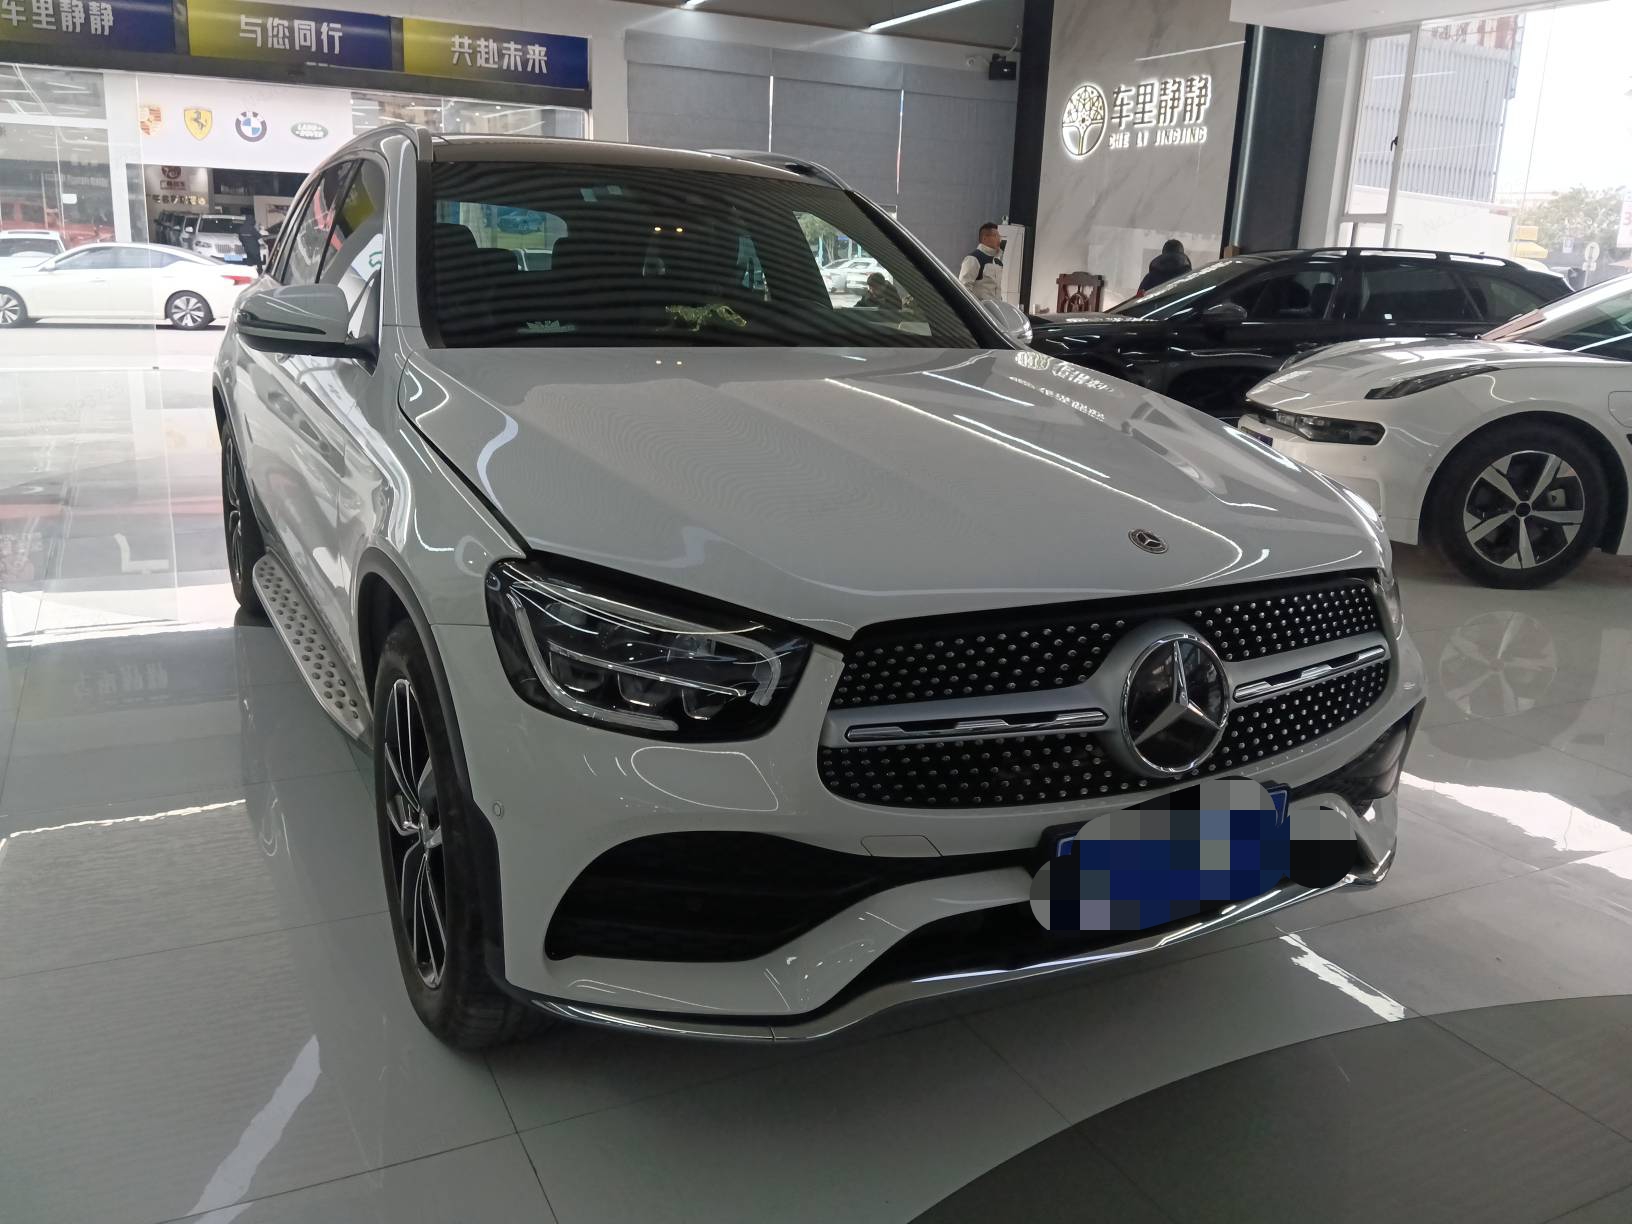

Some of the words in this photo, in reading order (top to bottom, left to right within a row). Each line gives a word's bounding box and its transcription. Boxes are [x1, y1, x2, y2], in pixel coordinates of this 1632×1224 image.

[0, 0, 114, 35] 车里静静
[239, 14, 343, 54] 与您同行
[451, 34, 547, 74] 共赴未来
[1110, 74, 1212, 130] 车里静静
